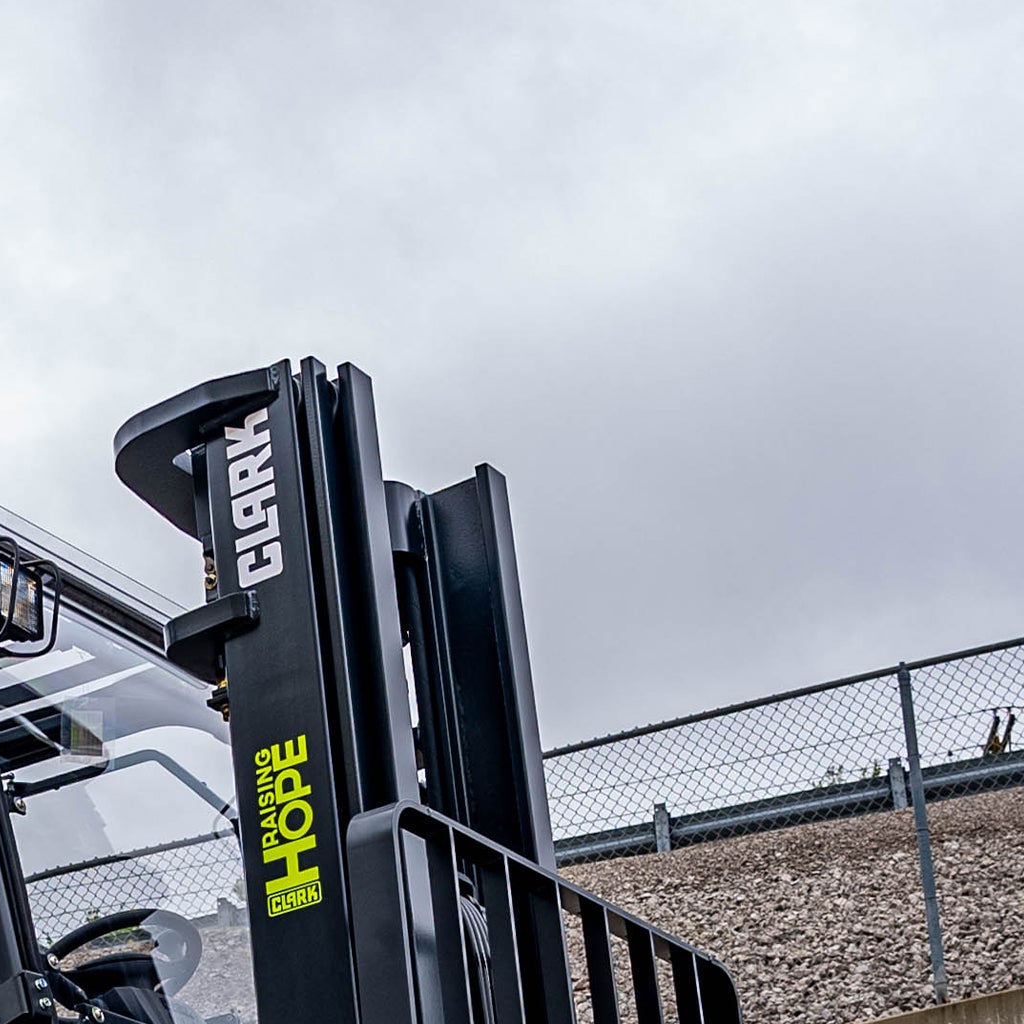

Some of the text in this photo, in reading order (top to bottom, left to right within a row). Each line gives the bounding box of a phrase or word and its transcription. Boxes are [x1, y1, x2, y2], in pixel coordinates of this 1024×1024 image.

[224, 407, 283, 588] CLARK
[255, 748, 279, 848] RAISING
[262, 734, 320, 895] HOPE
[270, 884, 319, 914] CLARK
